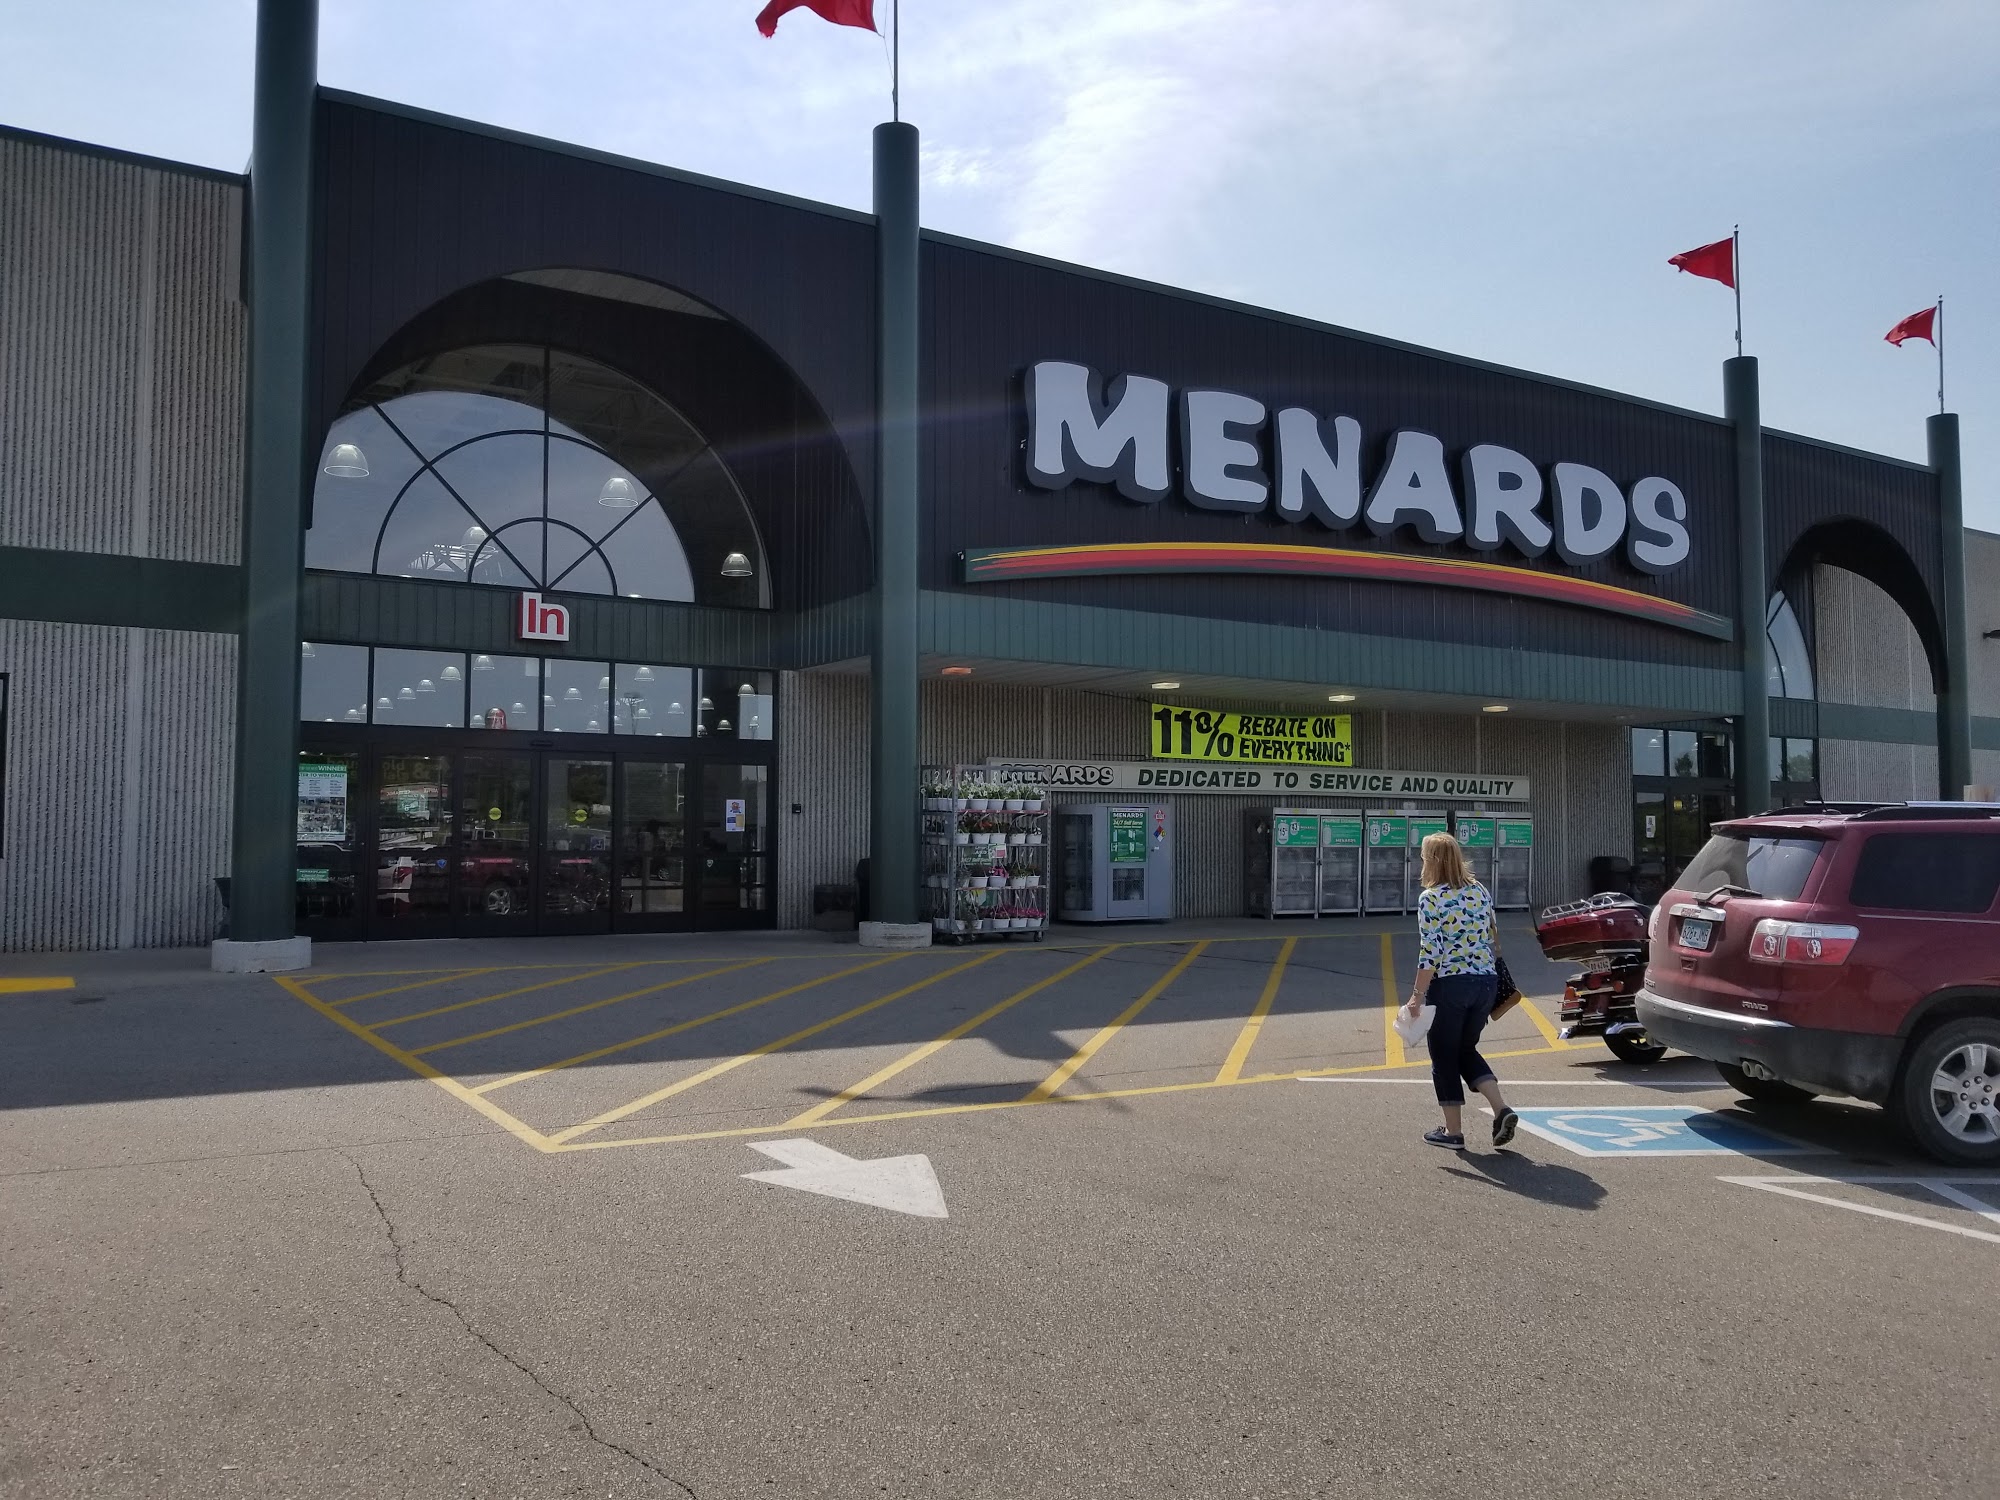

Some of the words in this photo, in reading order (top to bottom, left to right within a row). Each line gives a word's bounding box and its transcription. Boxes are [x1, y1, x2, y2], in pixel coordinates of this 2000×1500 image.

[1026, 360, 1691, 574] MENARDS
[527, 598, 565, 636] In
[1153, 707, 1235, 757] 11%
[1238, 715, 1309, 738] REBATE
[1312, 717, 1336, 738] ON
[1138, 768, 1262, 788] DEDICATED
[1272, 771, 1299, 788] TO
[1309, 772, 1393, 792] SERVICE
[1399, 777, 1438, 793] AND
[1443, 778, 1514, 796] QUALITY
